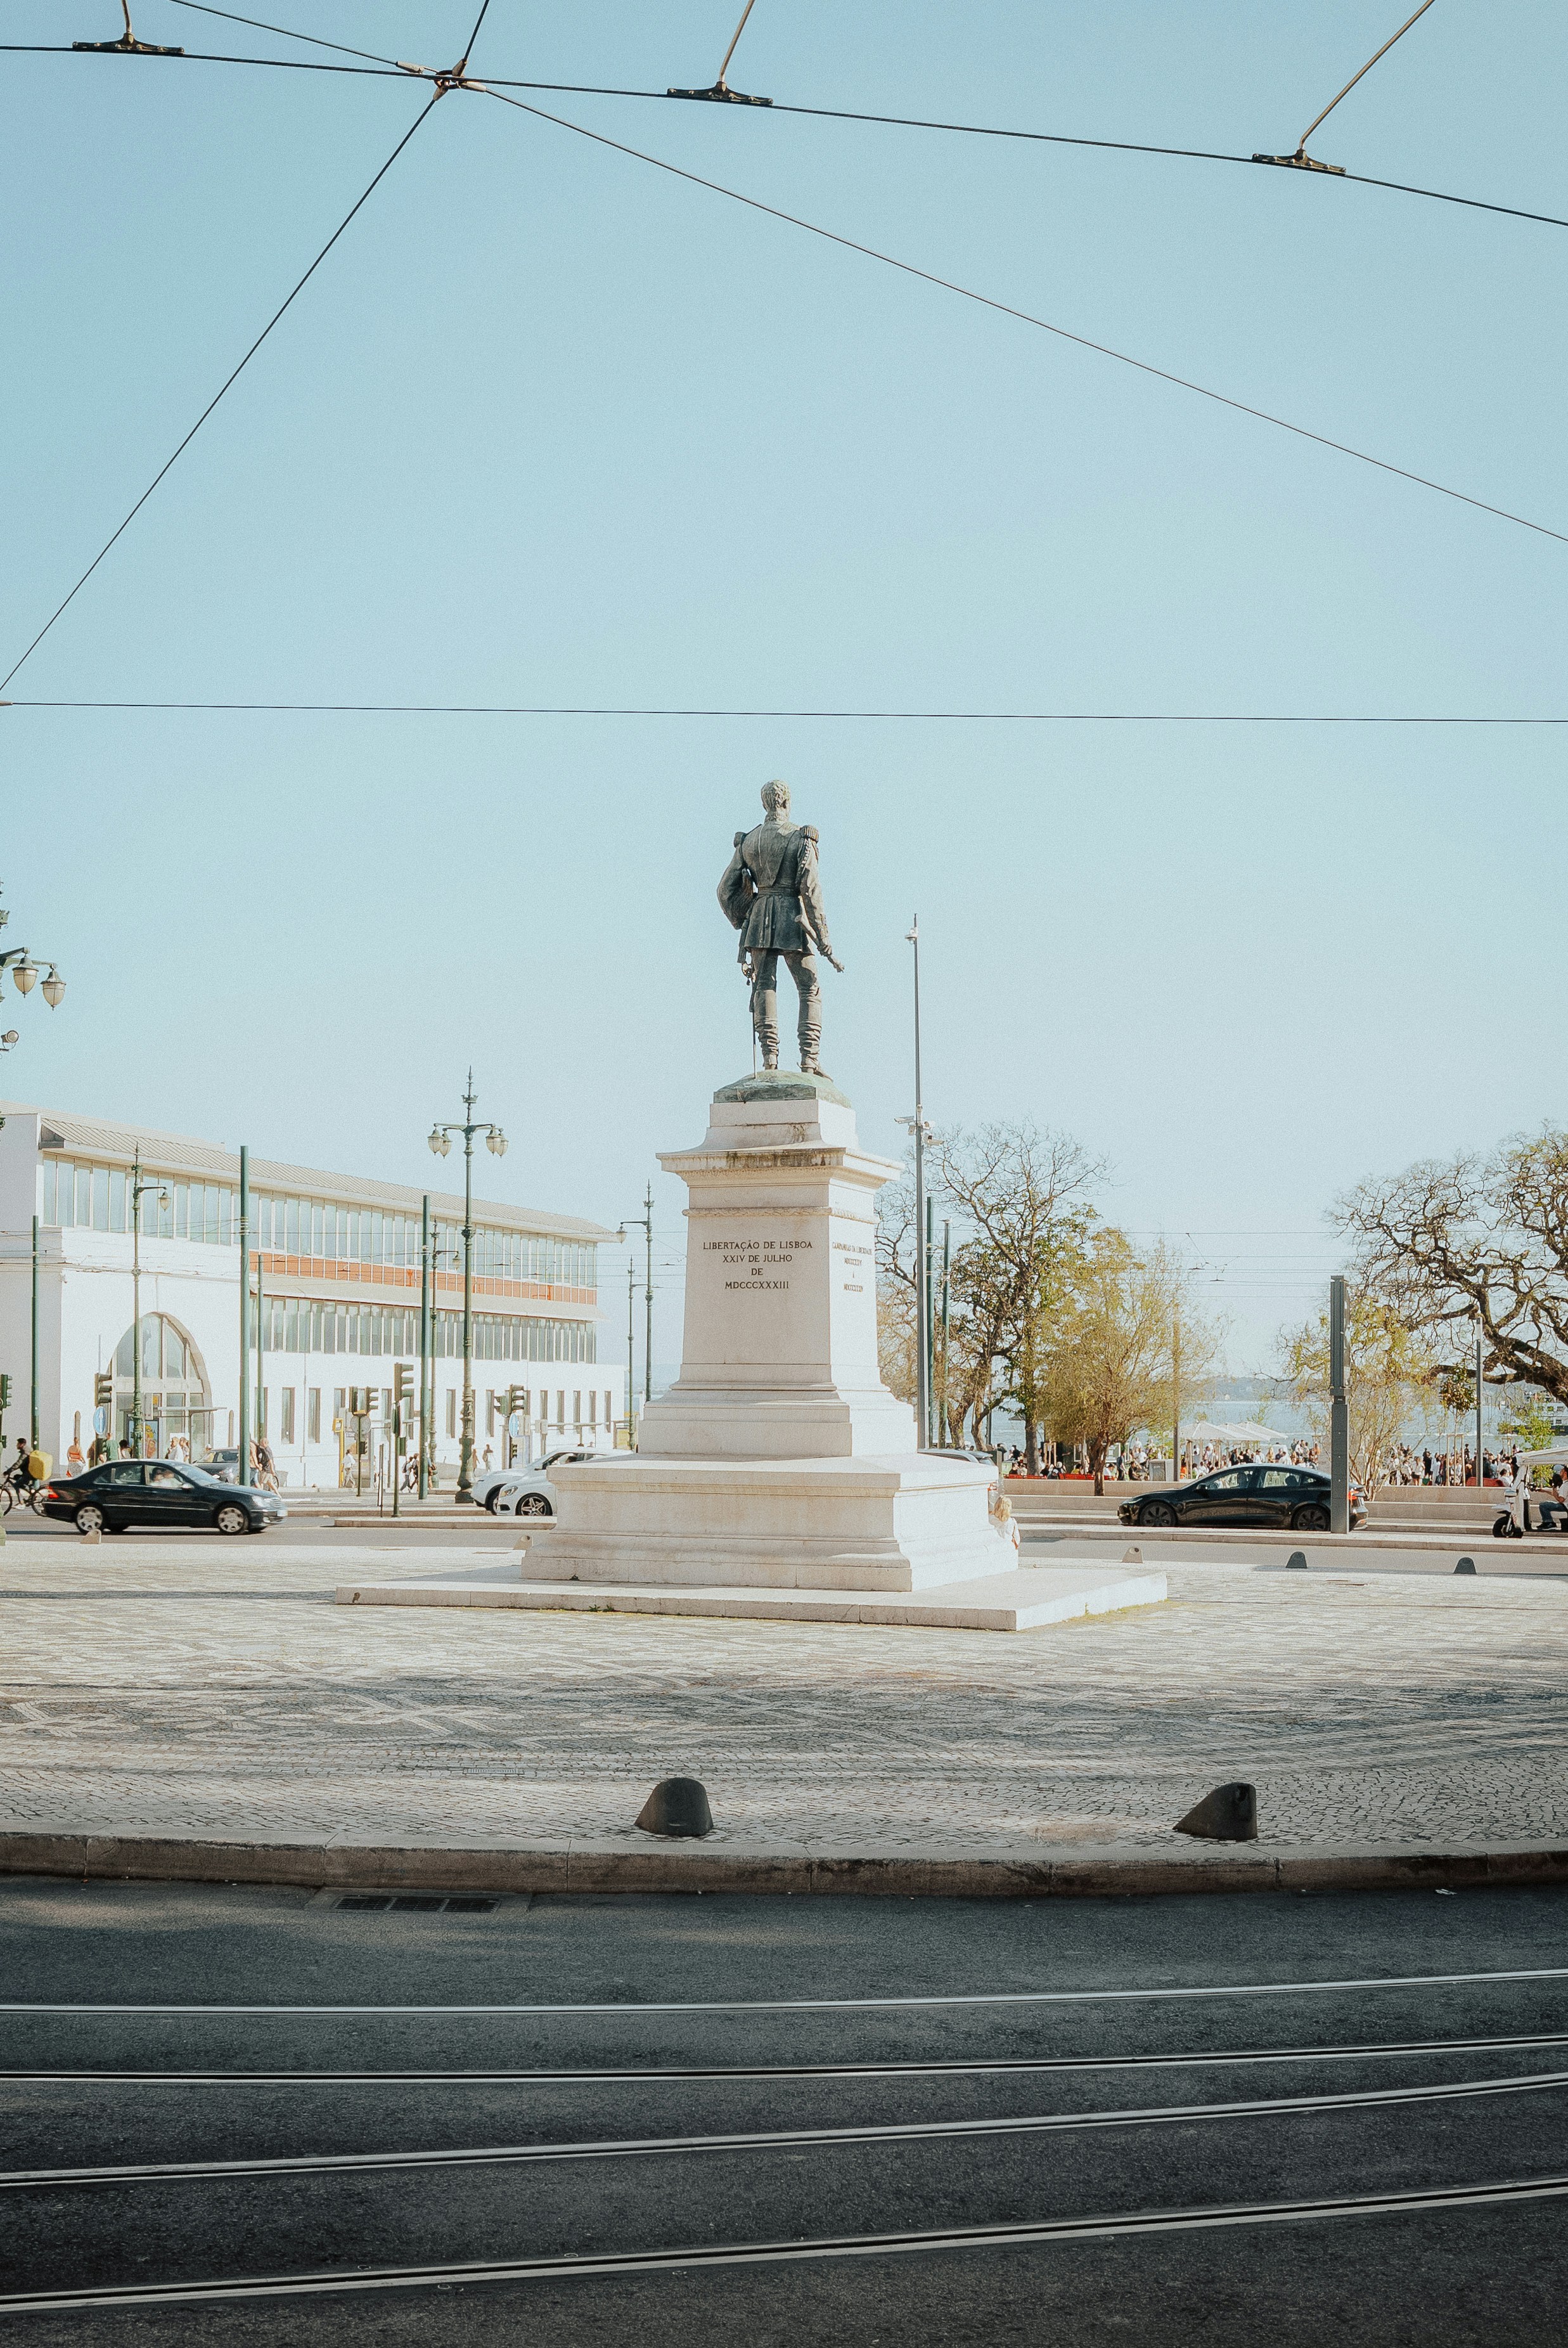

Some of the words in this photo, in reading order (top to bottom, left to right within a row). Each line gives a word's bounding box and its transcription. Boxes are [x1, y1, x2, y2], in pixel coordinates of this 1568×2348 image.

[703, 1240, 760, 1252] LIBERTAÇÃO
[763, 1241, 776, 1249] DE
[780, 1241, 813, 1249] LISBOA
[723, 1255, 745, 1263] XXIV
[748, 1255, 760, 1263] DE
[763, 1254, 792, 1262] JULHO
[751, 1268, 763, 1276] DE
[724, 1281, 789, 1289] MDCCCXXXIII
